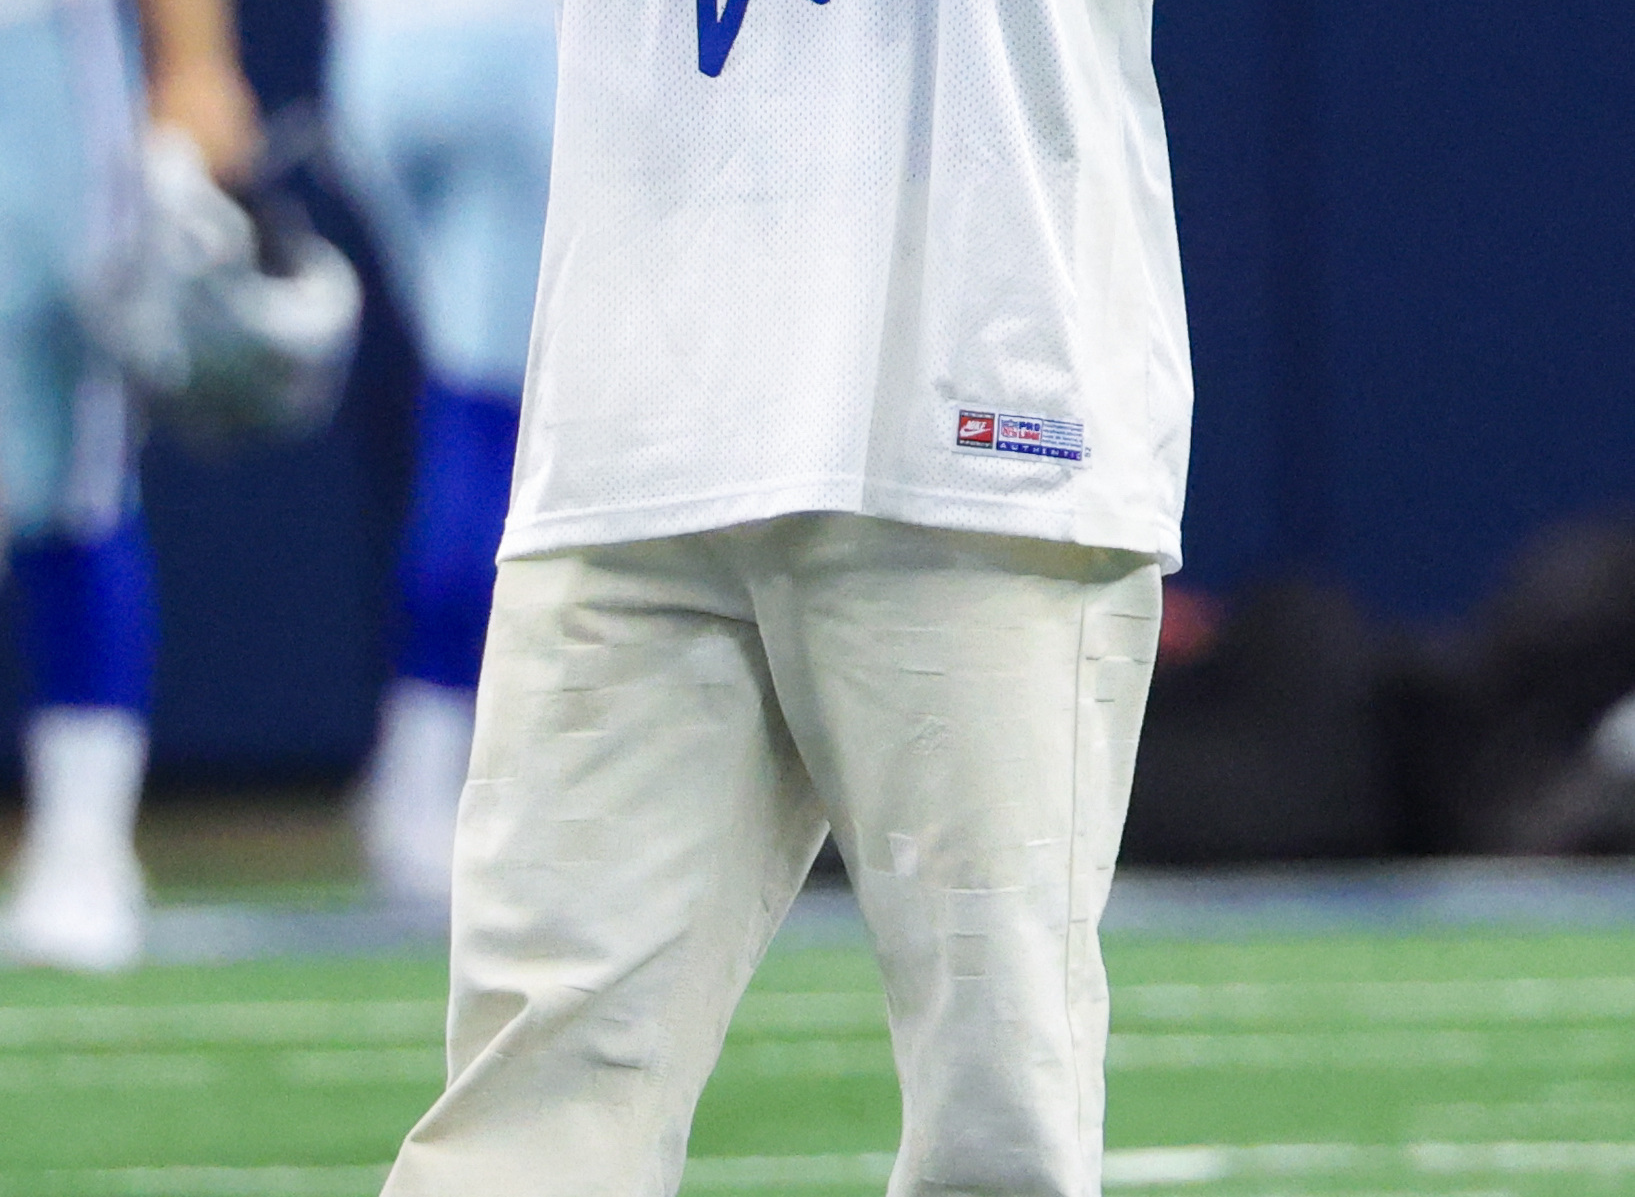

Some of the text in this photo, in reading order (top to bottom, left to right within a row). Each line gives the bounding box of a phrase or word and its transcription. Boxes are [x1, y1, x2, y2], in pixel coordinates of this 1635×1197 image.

[966, 420, 988, 430] NIKE
[1019, 421, 1040, 432] PRO
[999, 442, 1082, 460] AUTHENTIC
